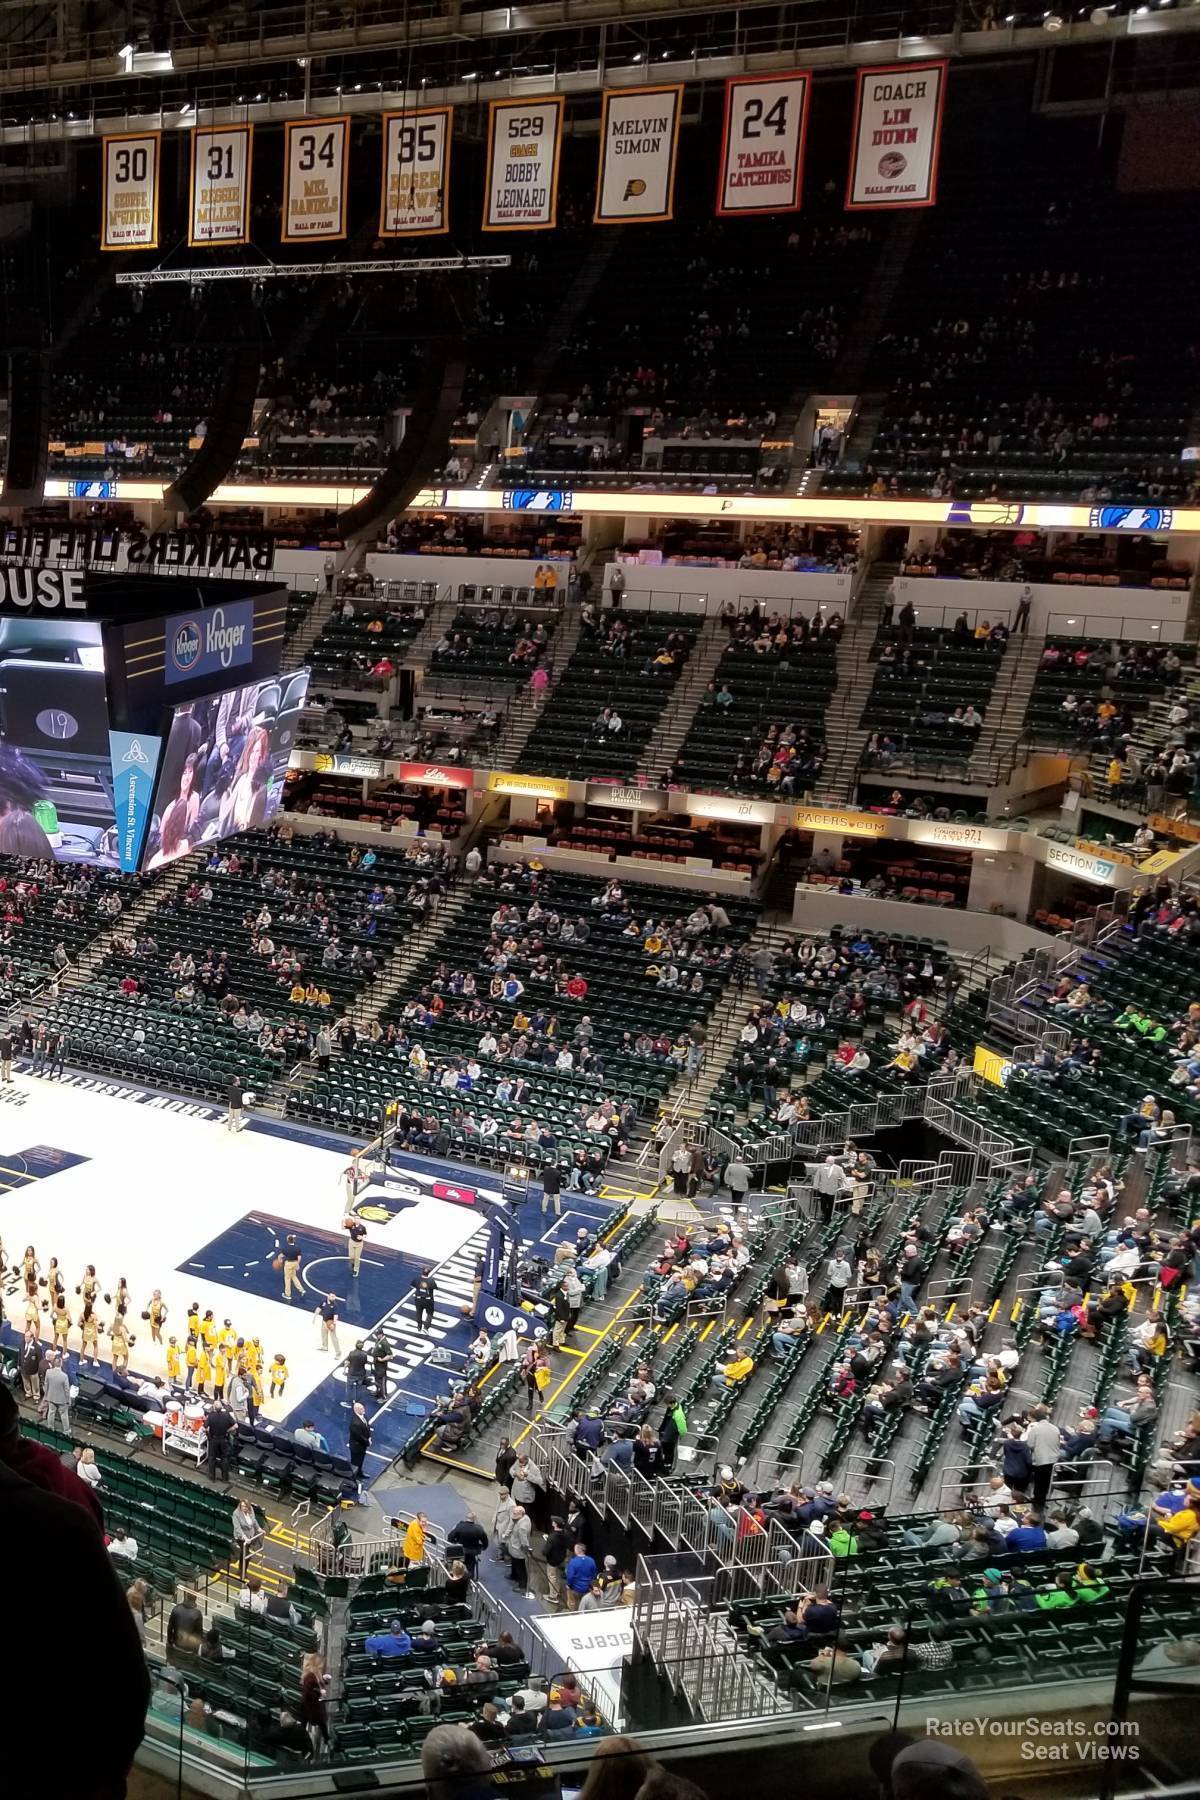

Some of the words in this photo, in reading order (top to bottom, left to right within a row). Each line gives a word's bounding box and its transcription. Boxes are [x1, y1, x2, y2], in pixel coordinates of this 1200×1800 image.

[873, 81, 927, 102] COACH
[508, 116, 544, 138] 529
[612, 118, 668, 137] MELVIN
[742, 96, 789, 139] 24
[882, 108, 912, 126] LIN
[397, 124, 437, 163] 35
[614, 138, 661, 155] SIMON
[871, 127, 918, 146] DUNN
[298, 132, 335, 170] 34
[510, 143, 538, 157] COACH
[737, 150, 786, 169] TAMIKA
[115, 148, 147, 183] 30
[207, 145, 234, 180] 31
[505, 162, 541, 183] BOBBY
[390, 170, 441, 191] ROGER
[729, 169, 792, 188] CATCHINGS
[496, 188, 546, 208] LEONARD
[497, 210, 514, 218] HALL
[523, 209, 542, 217] FAME
[176, 630, 199, 663] Kroger
[206, 608, 246, 668] Kroger
[50, 712, 68, 739] 19
[127, 773, 140, 815] Ascension
[127, 817, 136, 828] St.
[964, 828, 982, 841] 97.1
[124, 830, 136, 861] Vincent
[1050, 848, 1093, 870] SECTION
[146, 1095, 214, 1120] GROW
[571, 1633, 632, 1650] acers
